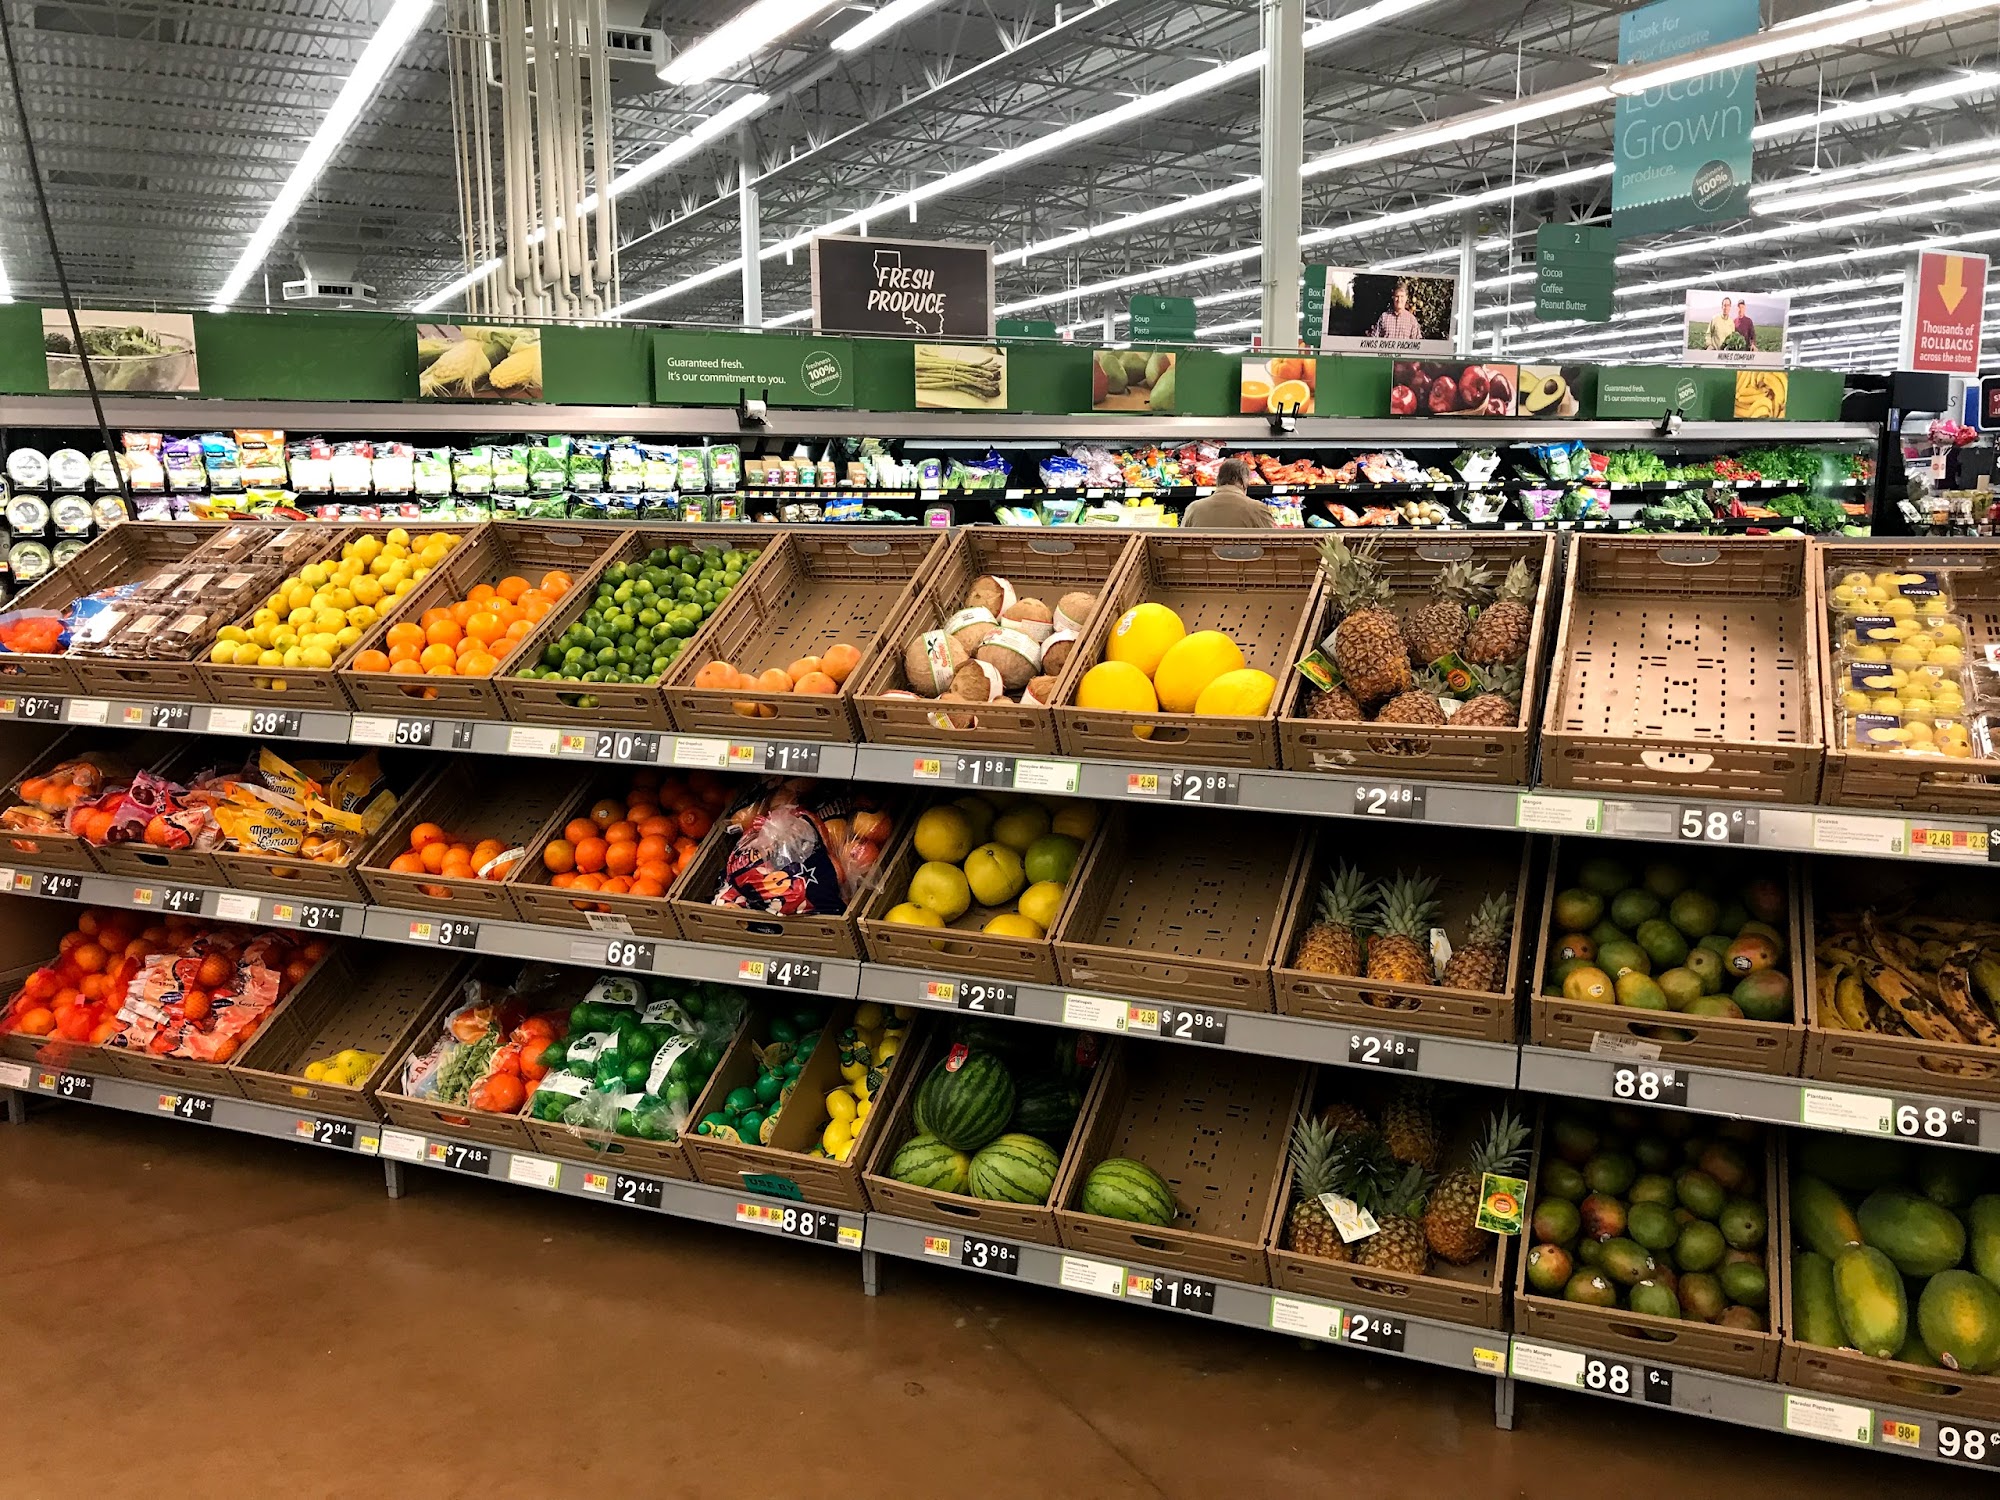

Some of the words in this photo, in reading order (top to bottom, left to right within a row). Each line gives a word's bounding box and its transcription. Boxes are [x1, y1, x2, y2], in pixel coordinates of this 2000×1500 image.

[1662, 16, 1680, 31] for
[1623, 105, 1742, 160] Grown
[1621, 164, 1677, 189] produce.
[1697, 173, 1728, 196] 100%
[1574, 233, 1580, 244] 2
[1543, 251, 1555, 261] Tea
[877, 266, 935, 289] FRESH
[1541, 267, 1563, 278] Cocoa
[1308, 288, 1321, 297] Box
[1541, 283, 1564, 294] Coffee
[867, 290, 947, 314] PRODUCE
[1160, 302, 1166, 311] 6
[1540, 299, 1565, 310] Peanut
[1565, 300, 1587, 311] Butter
[1134, 315, 1150, 325] Soup
[1024, 325, 1029, 333] 8
[1134, 327, 1150, 335] Pasta
[1923, 320, 1964, 335] Thousands
[1965, 324, 1975, 336] of
[1360, 340, 1377, 349] KINGS
[1379, 341, 1396, 349] RIVER
[1397, 342, 1421, 350] PACKING
[1921, 336, 1974, 351] ROLLBACKS
[667, 357, 719, 369] Guaranteed
[720, 358, 744, 369] fresh.
[805, 357, 831, 371] freshness
[1734, 353, 1755, 361] COMPANY
[1919, 353, 1941, 362] across
[1942, 352, 1953, 362] the
[1954, 354, 1973, 363] store.
[667, 372, 681, 382] It's
[682, 373, 698, 382] our
[699, 372, 755, 383] commitment
[757, 375, 767, 384] to
[767, 376, 787, 386] you.
[807, 364, 836, 381] 100%
[809, 372, 839, 389] guaranteed
[1604, 384, 1632, 393] Guaranteed
[1632, 385, 1645, 393] fresh.
[1678, 388, 1694, 400] 100%
[1858, 714, 1895, 722] Guava
[396, 722, 431, 743] 58¢
[1681, 809, 1743, 841] 58¢
[250, 825, 284, 841] Meyer
[257, 836, 299, 850] Lemons
[655, 1036, 680, 1066] LIMES
[1614, 1069, 1673, 1100] 88¢
[1806, 1093, 1833, 1101] Plantains
[1897, 1105, 1963, 1138] 68¢
[748, 1177, 775, 1188] USE
[778, 1183, 795, 1192] BY
